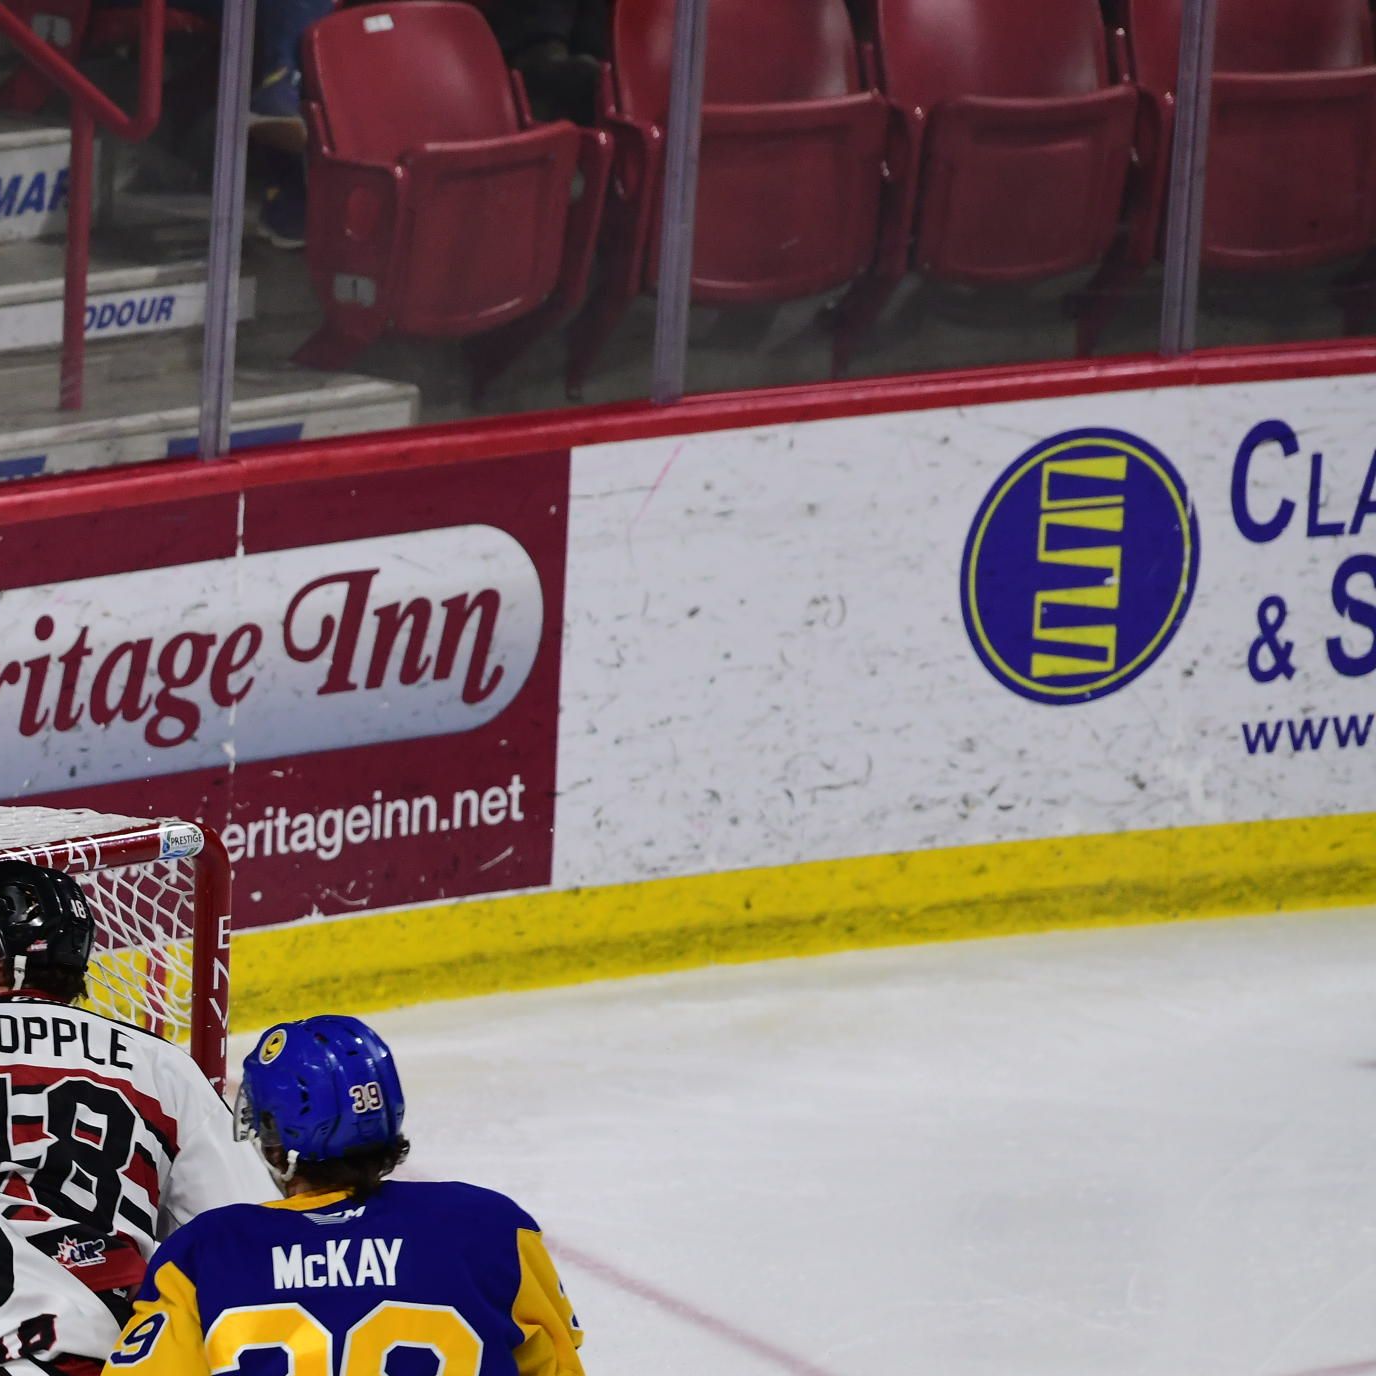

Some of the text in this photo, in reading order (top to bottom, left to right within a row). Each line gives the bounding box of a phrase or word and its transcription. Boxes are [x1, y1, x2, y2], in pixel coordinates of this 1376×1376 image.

[282, 568, 505, 706] Inn
[1247, 595, 1296, 684] &
[170, 832, 203, 847] PRESTIGE
[349, 1081, 384, 1114] 39
[272, 1238, 404, 1289] McKAY
